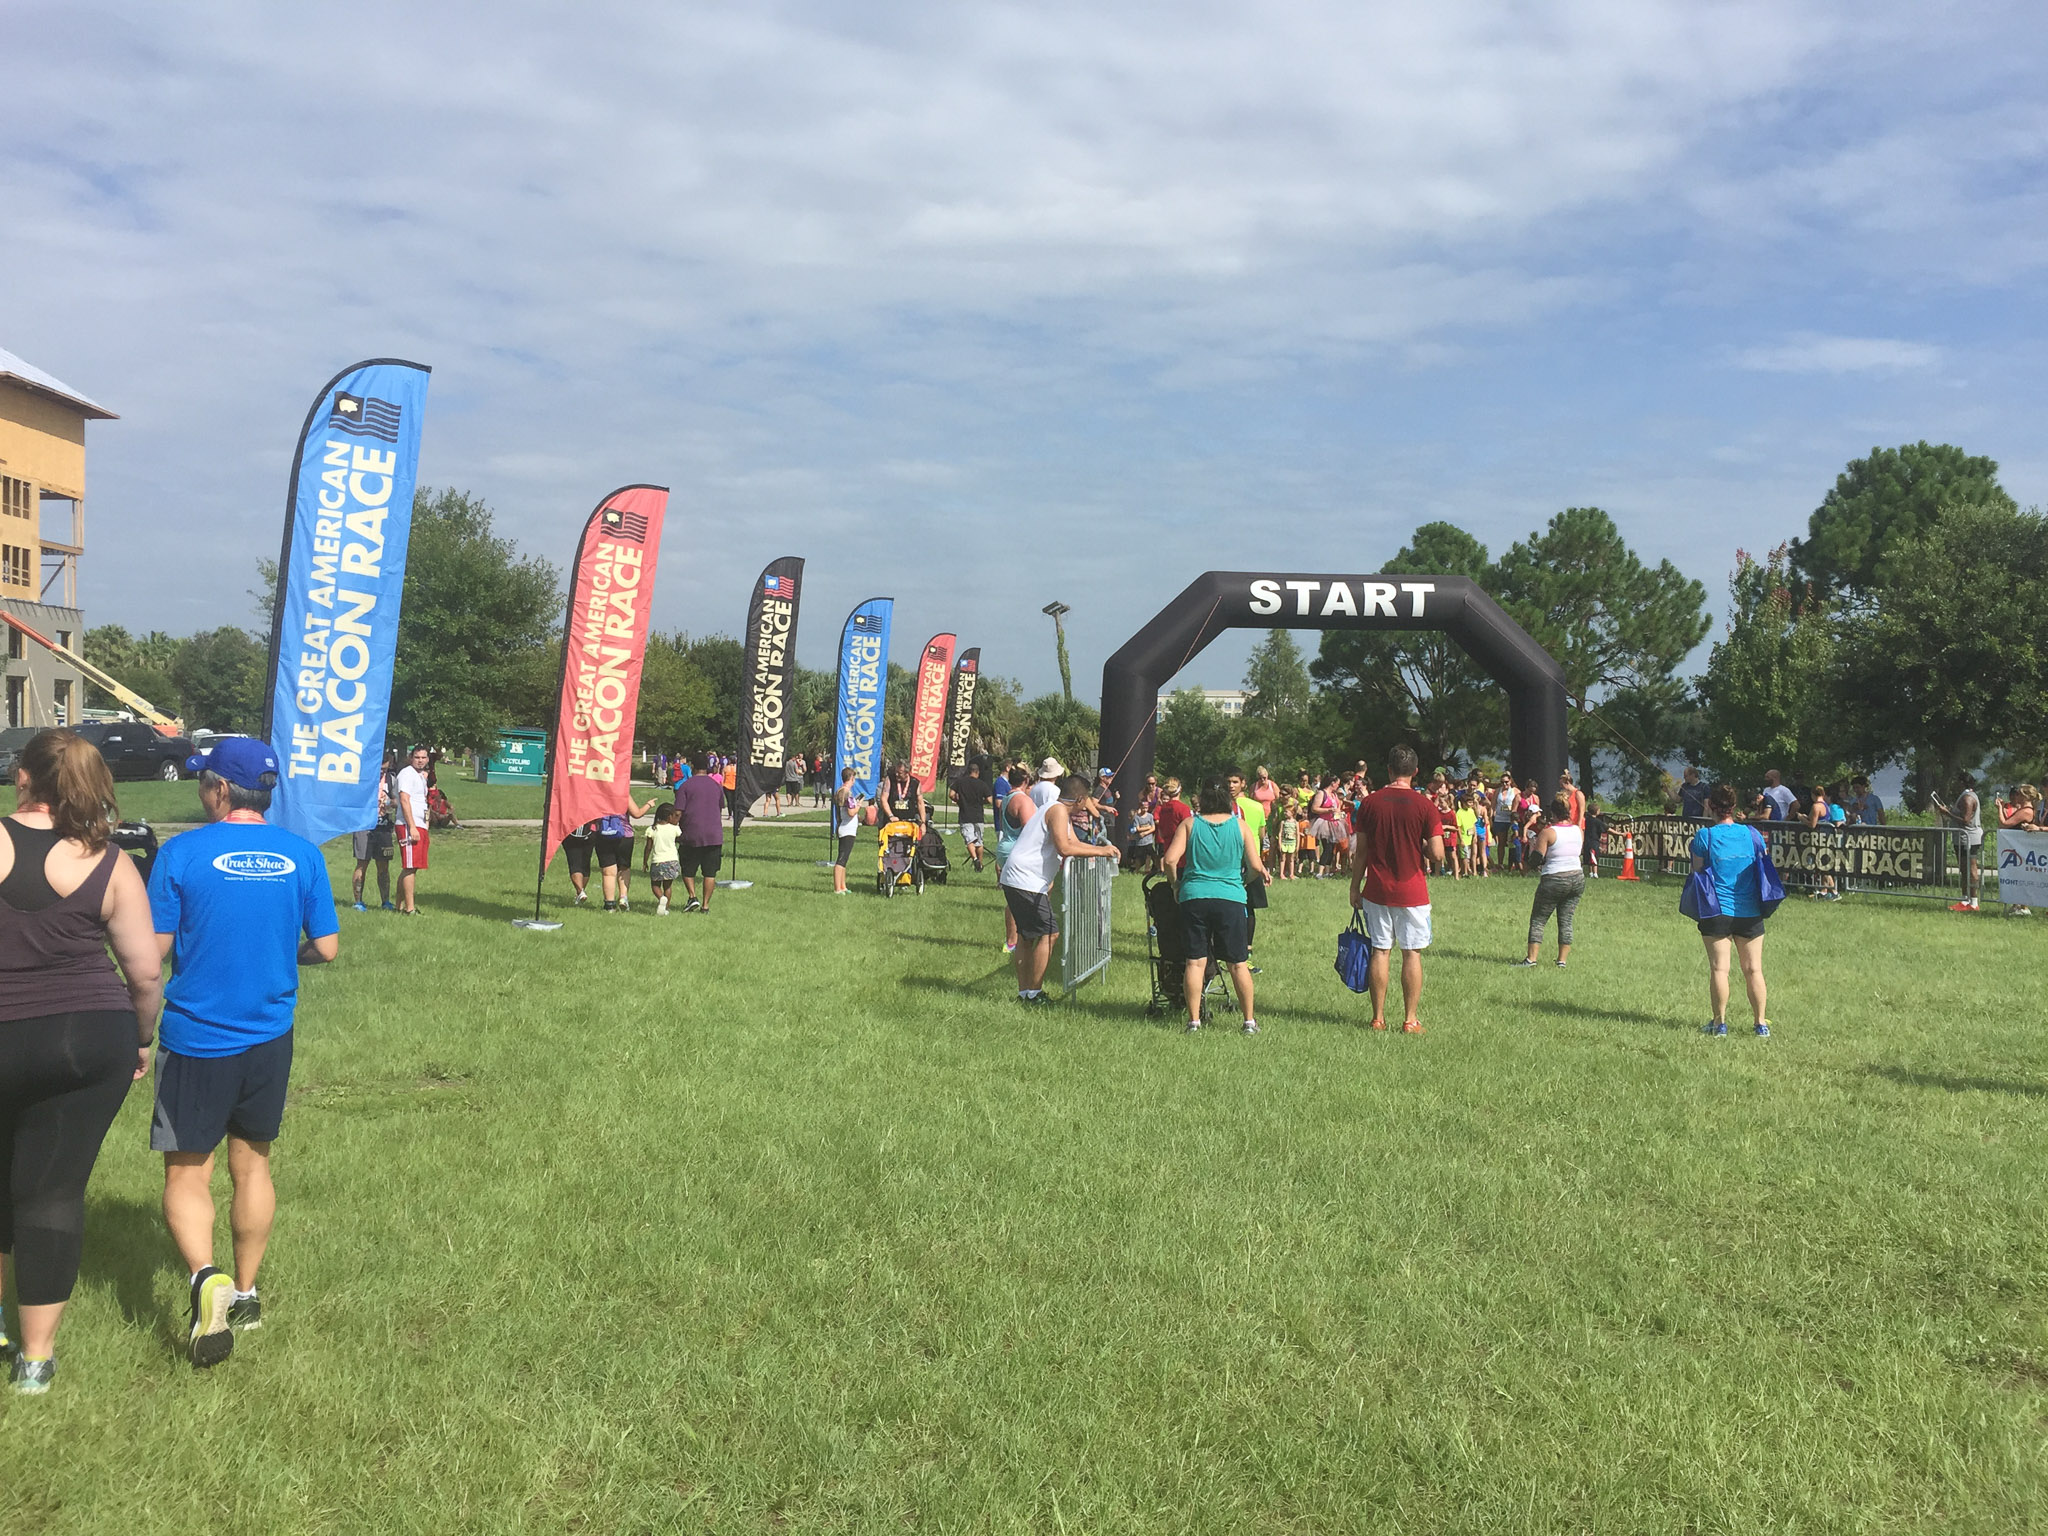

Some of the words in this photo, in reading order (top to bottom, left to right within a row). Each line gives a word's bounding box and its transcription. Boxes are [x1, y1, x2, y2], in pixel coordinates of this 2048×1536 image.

[308, 440, 351, 607] AMERICAN
[340, 446, 397, 578] RACE
[583, 542, 615, 656] AMERICAN
[604, 545, 644, 639] RACE
[1248, 578, 1436, 618] START
[755, 599, 776, 684] AMERICAN
[769, 600, 793, 667] RACE
[296, 611, 332, 715] GREAT
[317, 586, 378, 785] BACON
[847, 635, 863, 708] AMERICAN
[859, 636, 882, 693] RACE
[919, 661, 934, 720] AMERICAN
[927, 663, 946, 708] RACE
[572, 660, 597, 733] GREAT
[585, 648, 632, 783] BACON
[752, 685, 766, 735] GREAT
[954, 672, 966, 719] AMERICAN
[963, 673, 976, 710] RACE
[762, 673, 784, 769] BACON
[844, 709, 857, 751] GREAT
[855, 698, 877, 781] BACON
[915, 720, 927, 754] GREAT
[918, 712, 941, 777] BACON
[952, 719, 961, 748] GREAT
[955, 713, 972, 767] BACON
[288, 724, 319, 779] THE
[567, 737, 588, 777] THE
[750, 737, 765, 766] THE
[911, 756, 921, 774] THE
[950, 749, 958, 766] THE
[1607, 834, 1659, 856] BAON
[1662, 834, 1695, 859] RAC
[1771, 830, 1796, 845] THE
[1800, 831, 1843, 848] GREAT
[1845, 834, 1924, 852] AMERICAN
[1771, 845, 1855, 874] BACON
[1861, 851, 1924, 880] RACE
